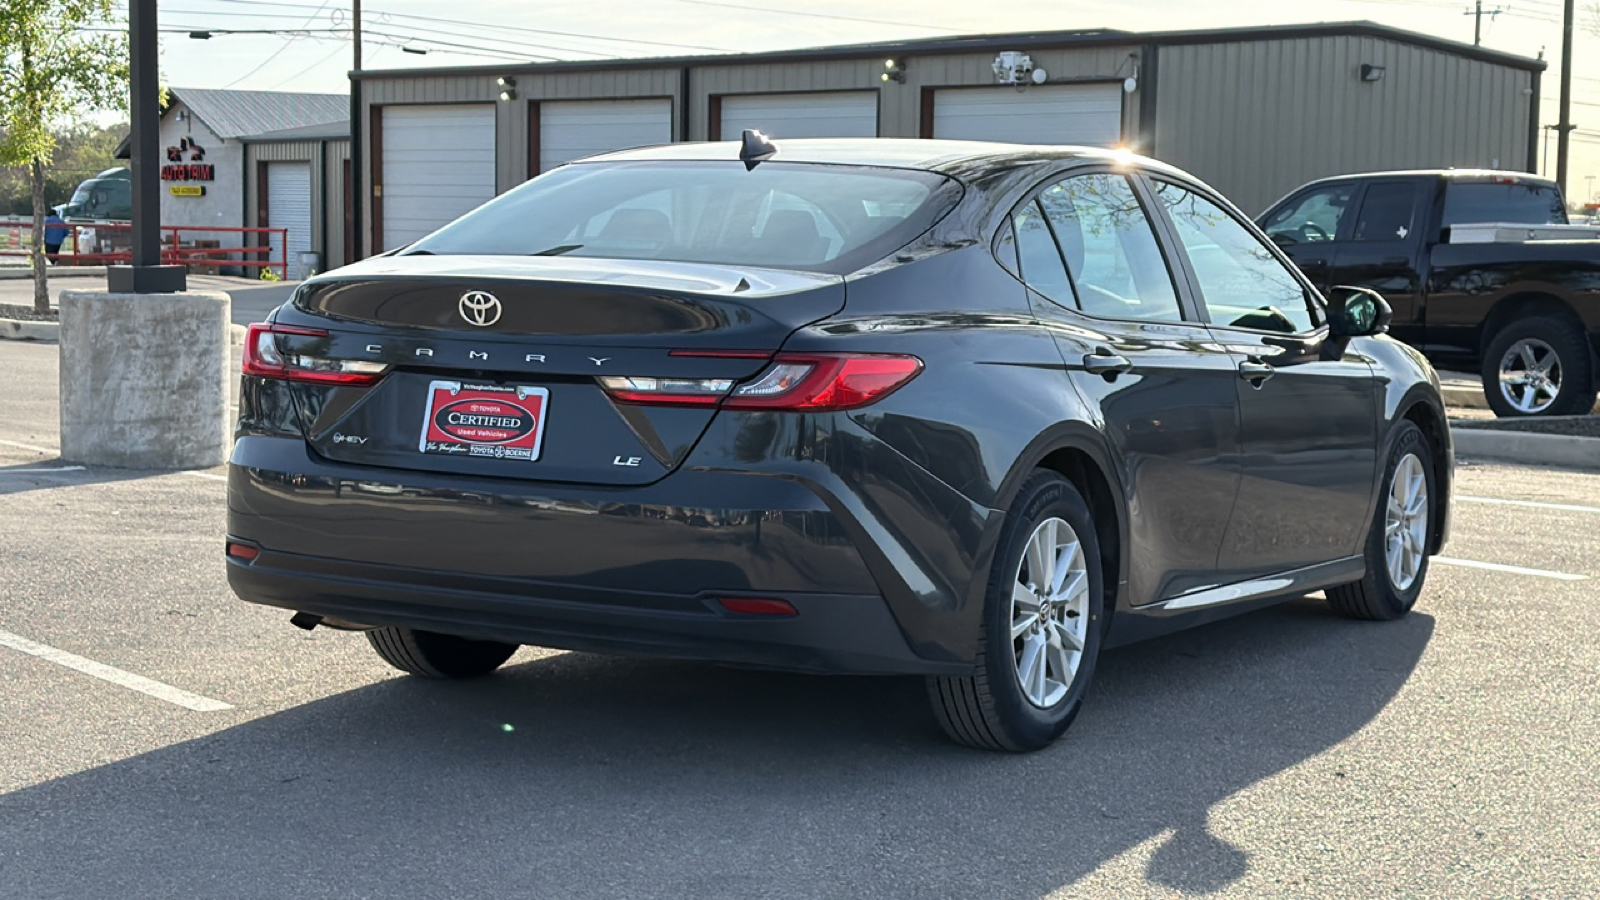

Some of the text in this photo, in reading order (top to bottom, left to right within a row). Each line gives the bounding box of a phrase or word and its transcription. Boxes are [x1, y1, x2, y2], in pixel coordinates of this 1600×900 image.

[366, 344, 611, 366] CAMRY
[457, 428, 507, 438] Used Vehicles
[613, 455, 642, 467] LE
